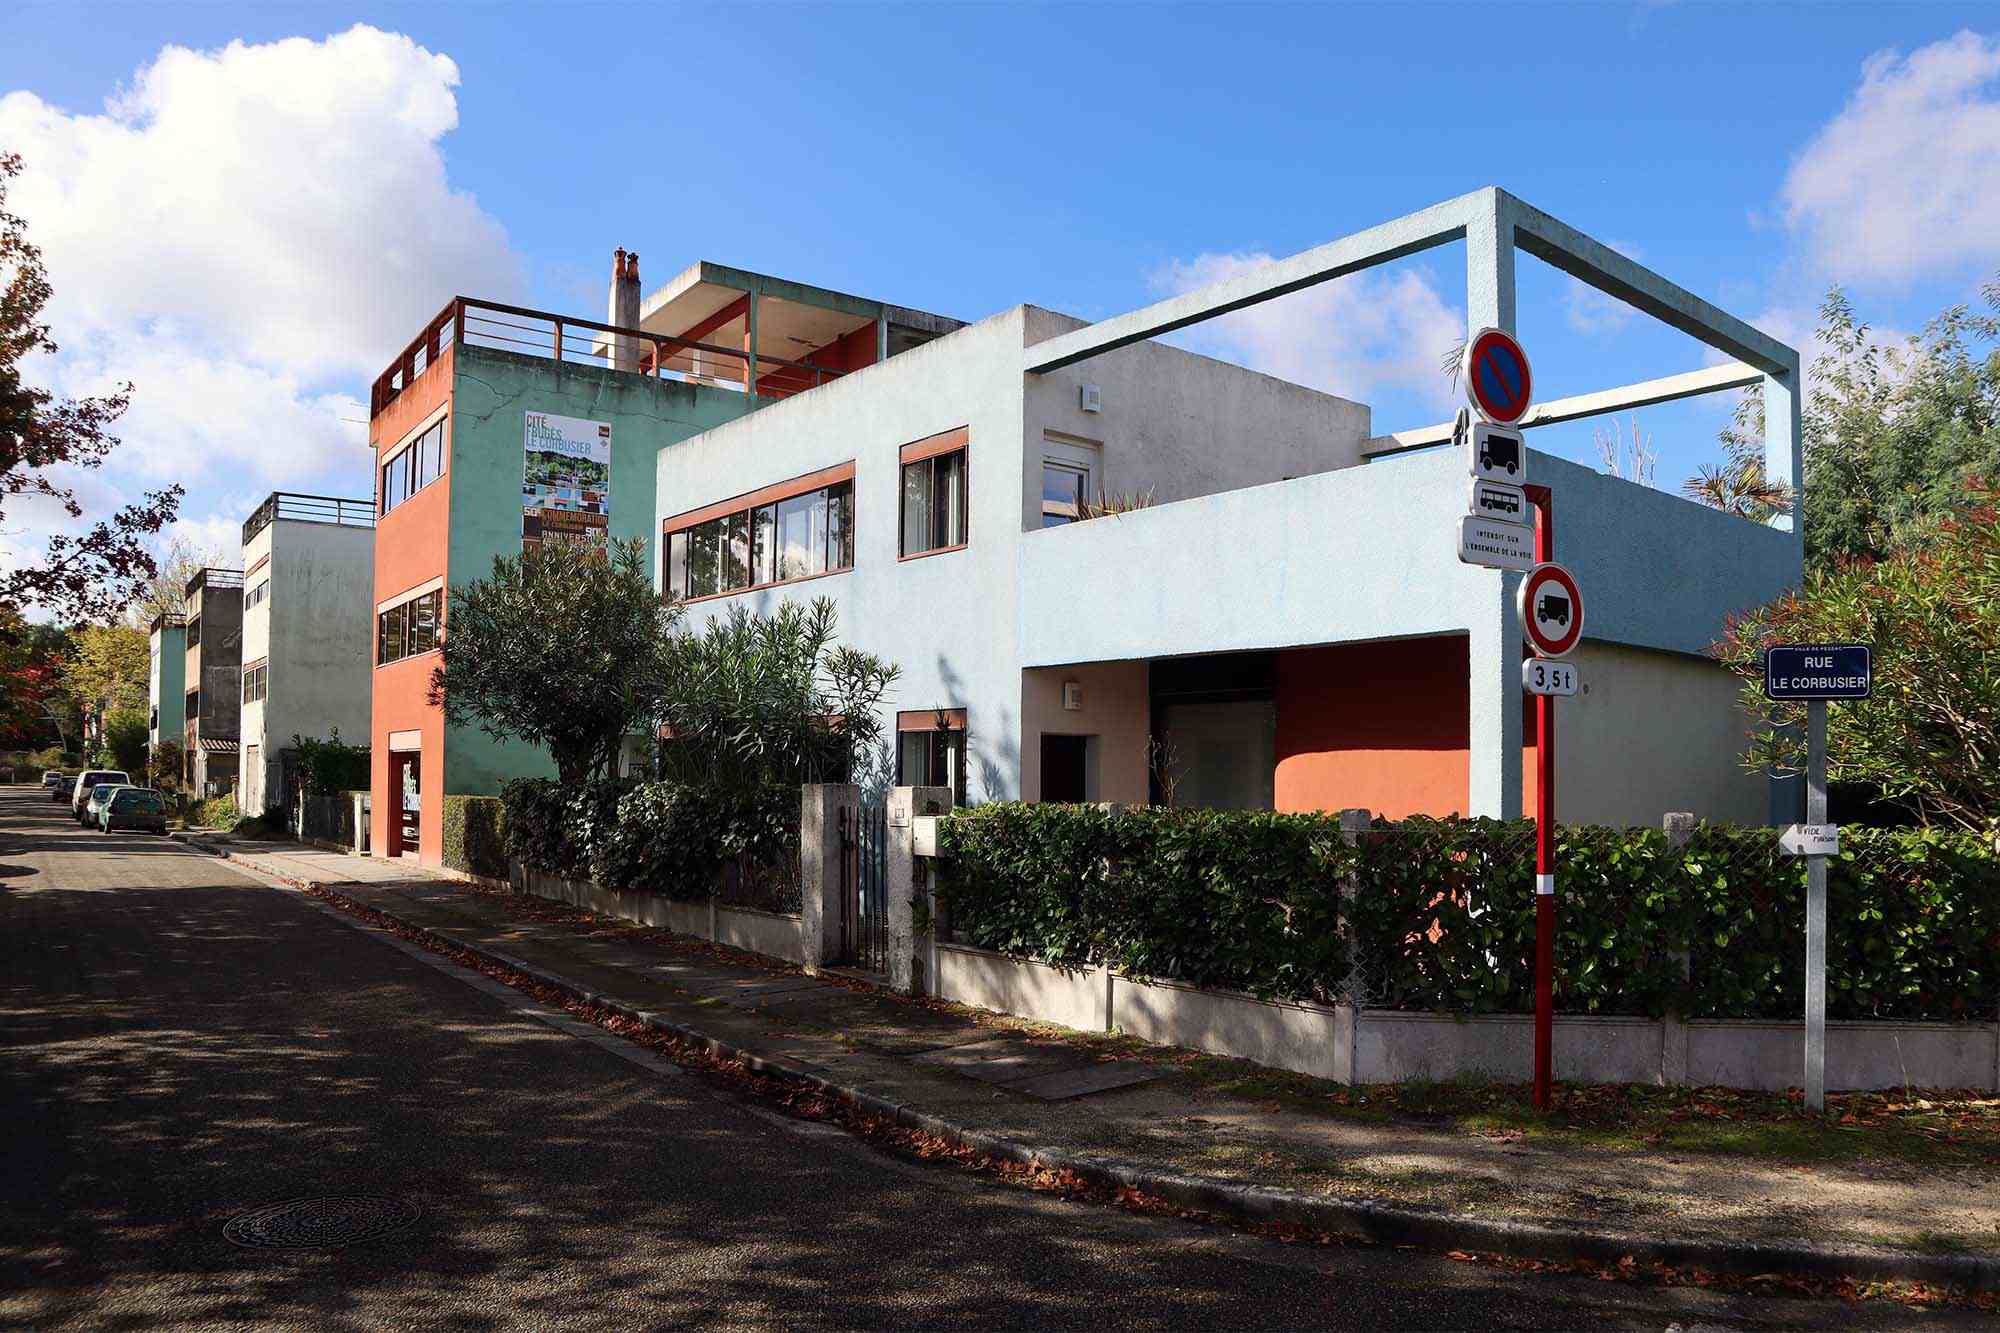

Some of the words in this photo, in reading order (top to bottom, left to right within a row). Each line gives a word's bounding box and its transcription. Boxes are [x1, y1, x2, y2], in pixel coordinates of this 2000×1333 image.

[1476, 530, 1505, 540] INTERDIT
[1507, 535, 1519, 543] SUR
[1501, 548, 1509, 556] DE
[1804, 656, 1833, 668] RUE
[1772, 677, 1788, 689] LE
[1791, 676, 1867, 689] CORBUSIER
